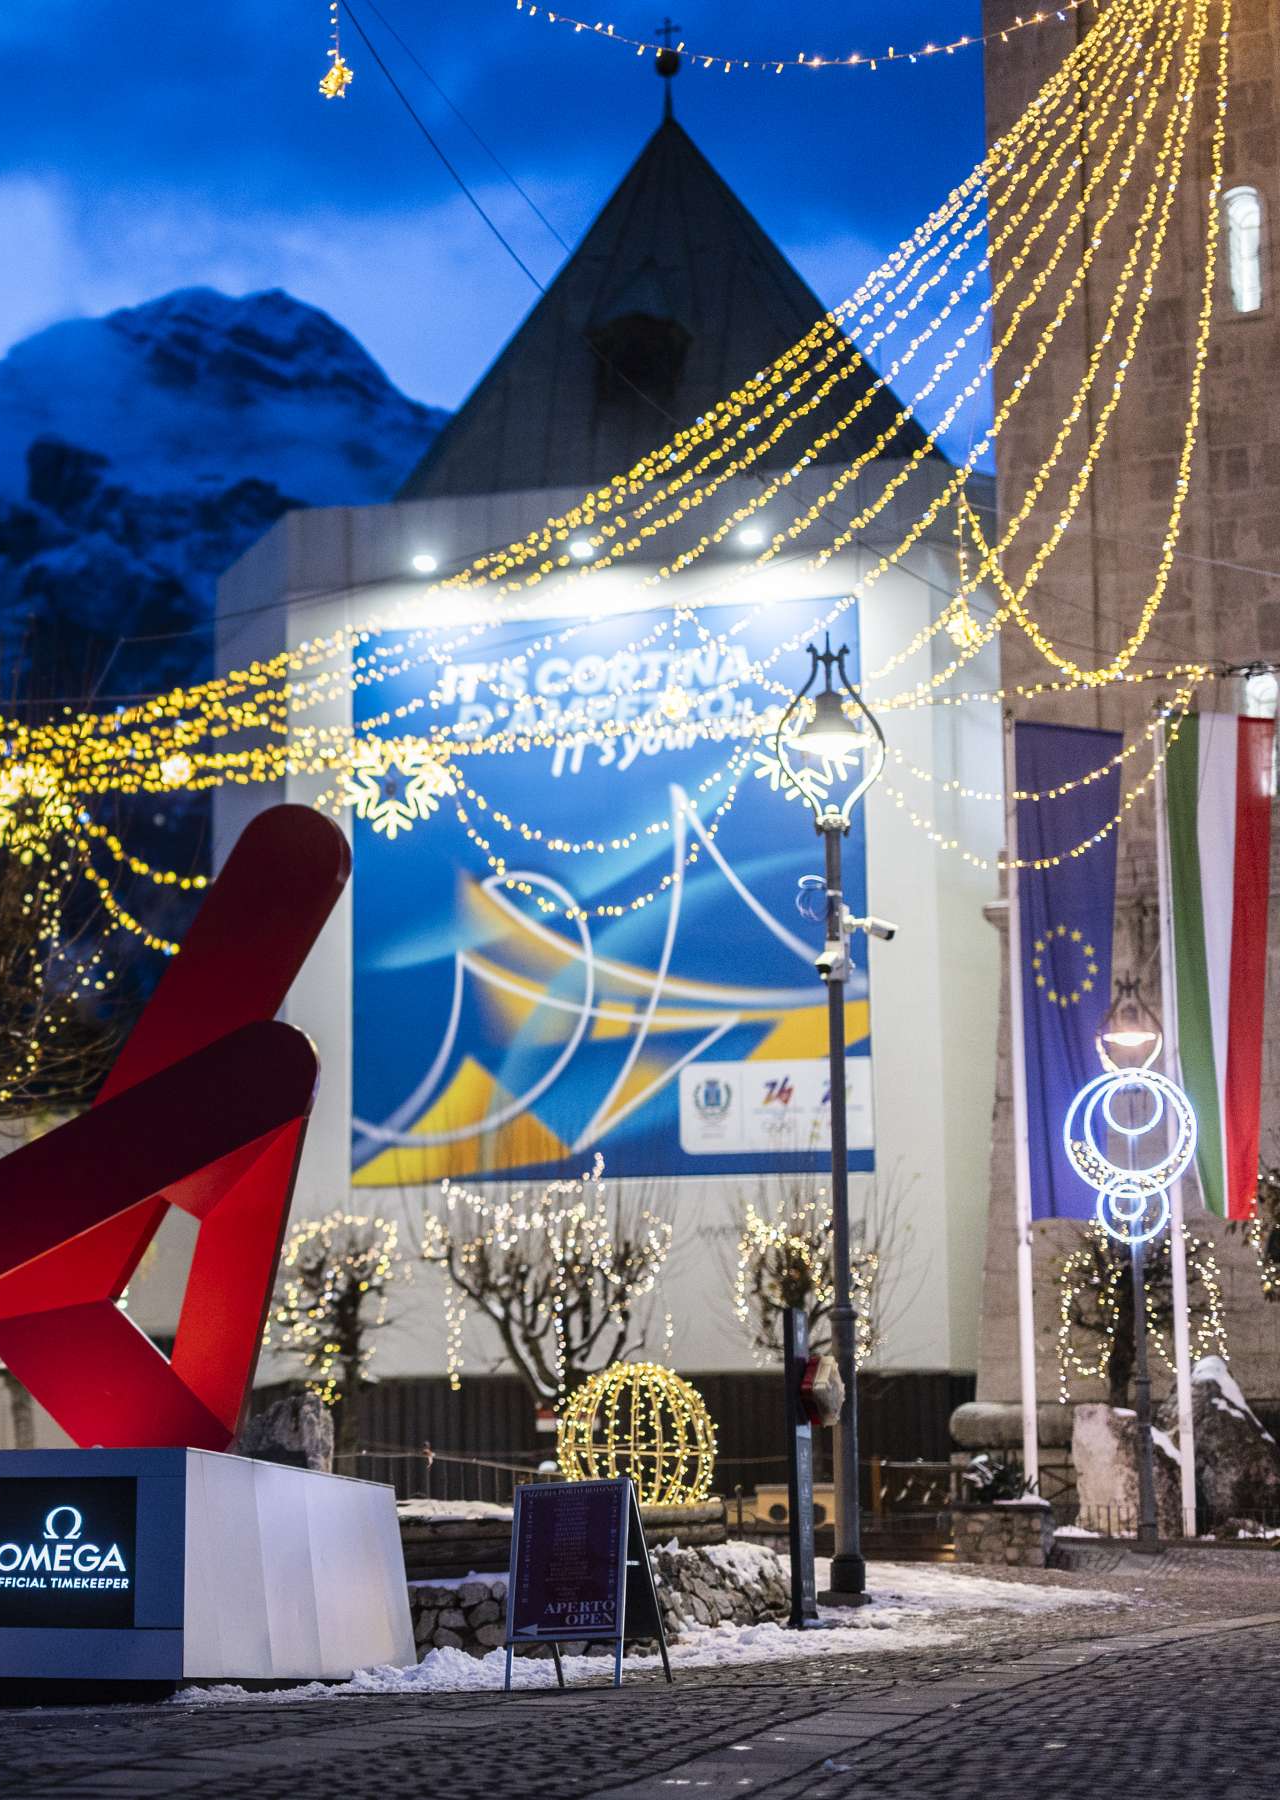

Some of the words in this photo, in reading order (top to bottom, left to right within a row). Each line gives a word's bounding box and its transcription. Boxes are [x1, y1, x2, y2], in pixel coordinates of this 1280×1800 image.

[534, 645, 751, 695] CORTINA
[50, 1577, 130, 1590] TIMEKEEPER
[544, 1600, 616, 1615] APERTO
[565, 1613, 615, 1626] OPEN
